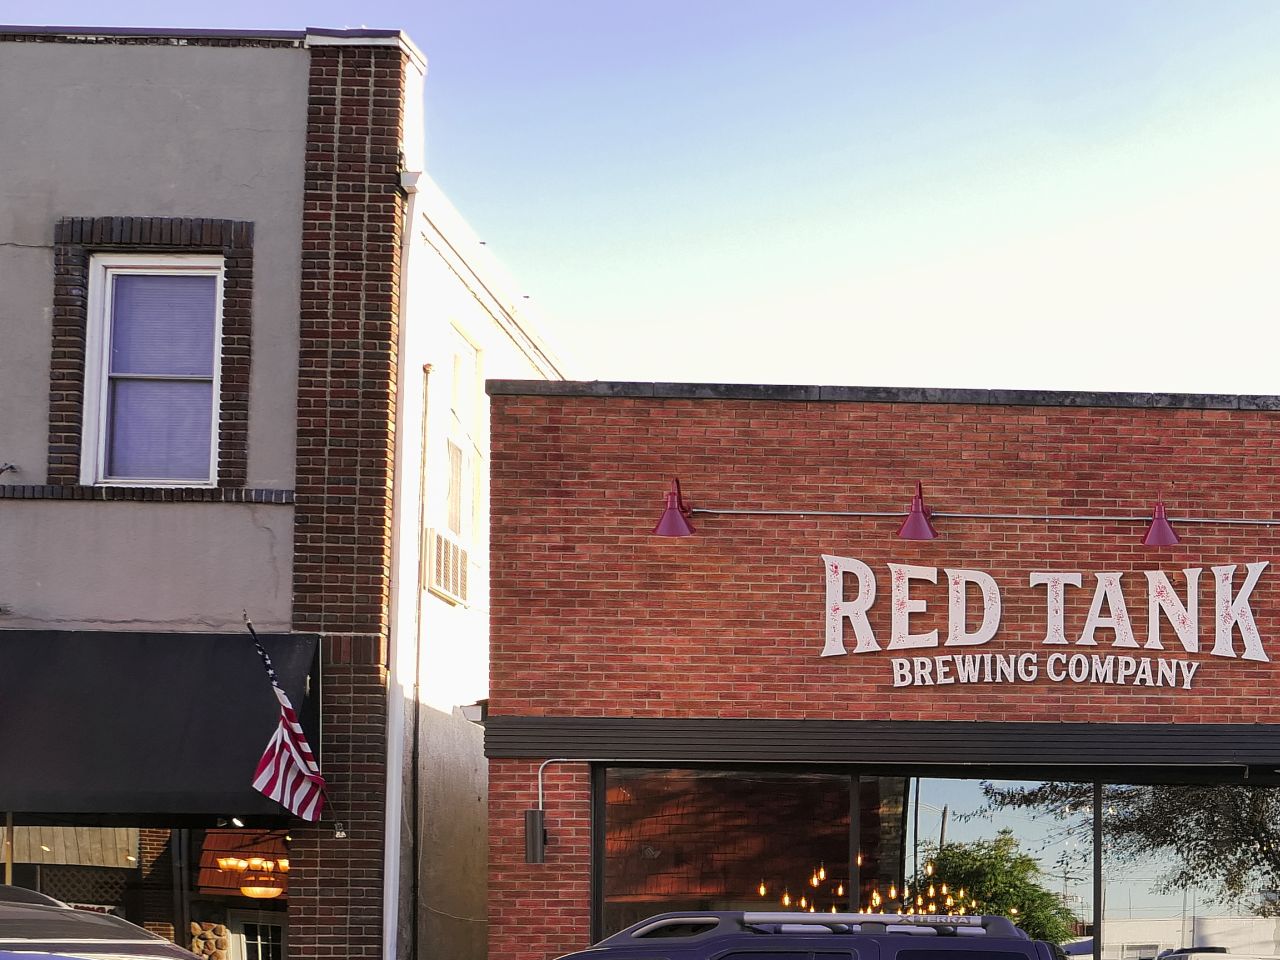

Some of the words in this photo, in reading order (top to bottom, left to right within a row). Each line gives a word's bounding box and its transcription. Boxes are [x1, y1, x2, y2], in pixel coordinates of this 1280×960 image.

[821, 554, 1002, 657] RED
[1029, 561, 1270, 662] TANK
[891, 652, 1038, 688] BREWING
[1046, 653, 1200, 690] COMPANY
